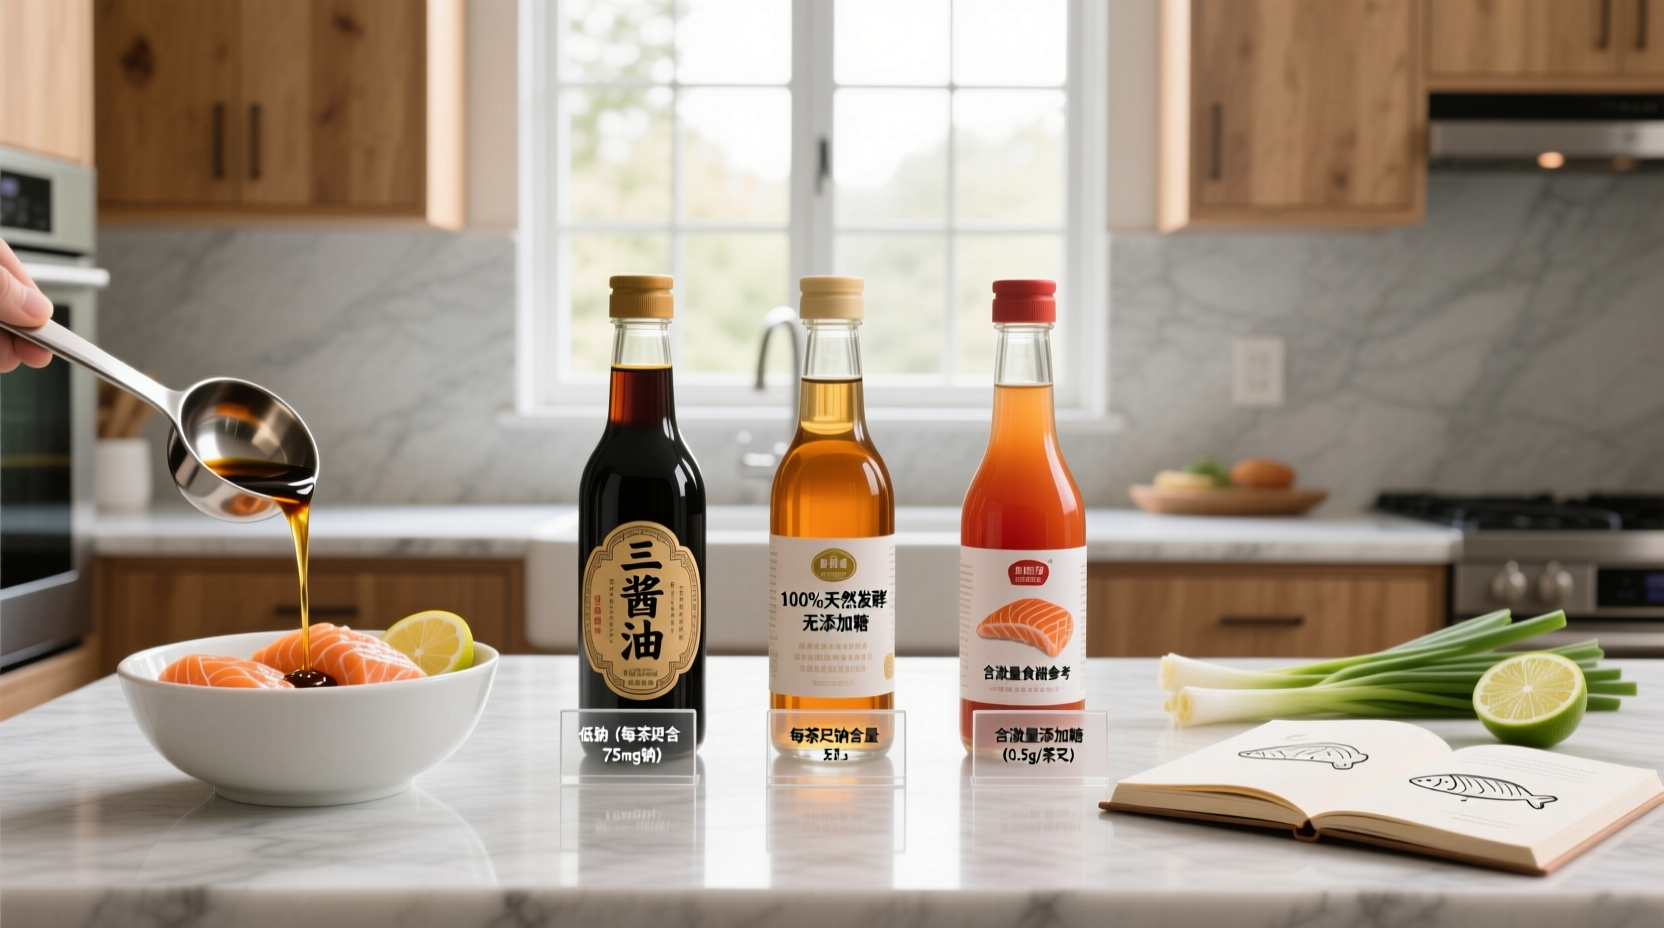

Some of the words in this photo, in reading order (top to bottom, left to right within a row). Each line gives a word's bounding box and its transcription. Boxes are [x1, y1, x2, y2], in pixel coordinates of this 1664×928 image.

[620, 540, 664, 661] 三酱油
[802, 613, 870, 633] 无添加糖
